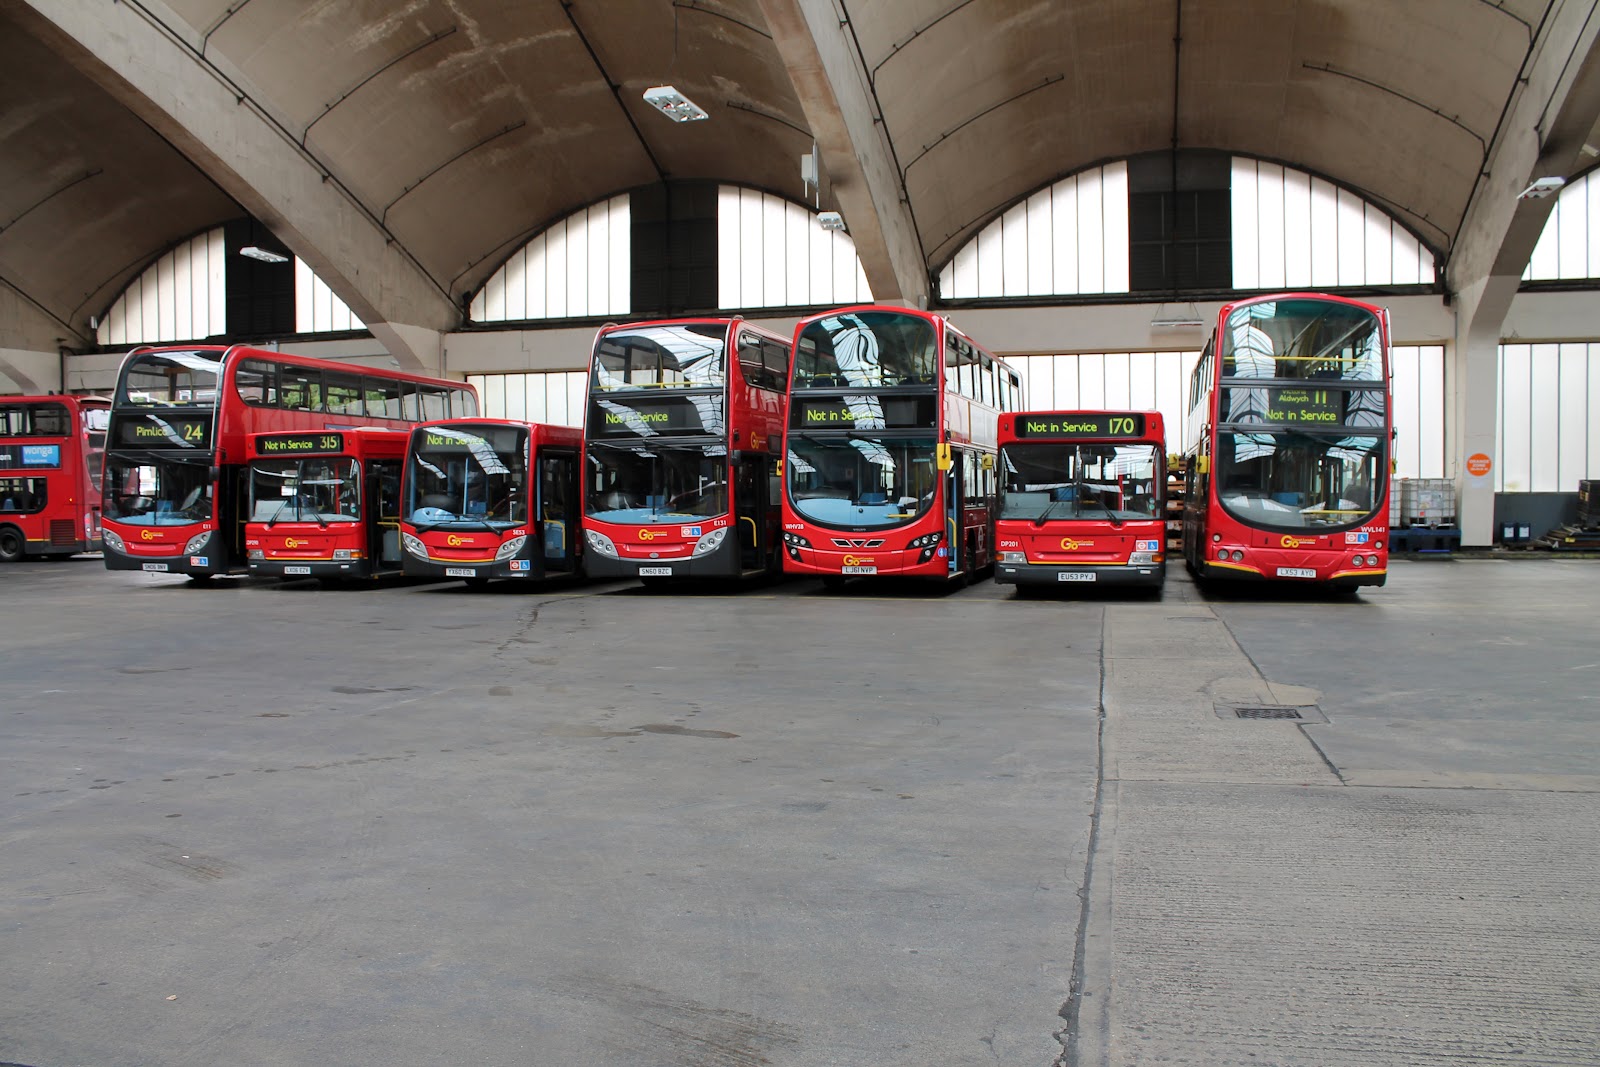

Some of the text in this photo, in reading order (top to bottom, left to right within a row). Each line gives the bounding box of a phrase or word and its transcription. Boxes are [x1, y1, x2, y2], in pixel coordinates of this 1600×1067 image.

[1278, 394, 1309, 404] Aldwych
[1315, 390, 1327, 404] 11
[636, 412, 668, 422] Service
[807, 410, 826, 421] Not
[830, 410, 838, 420] in
[1264, 408, 1337, 421] Not in Service
[1027, 417, 1134, 434] Not in Service 170
[136, 424, 204, 440] Pimlico 24
[264, 436, 337, 450] Not in Service 315
[426, 434, 443, 445] Not
[446, 436, 453, 445] in
[25, 447, 52, 457] wonga
